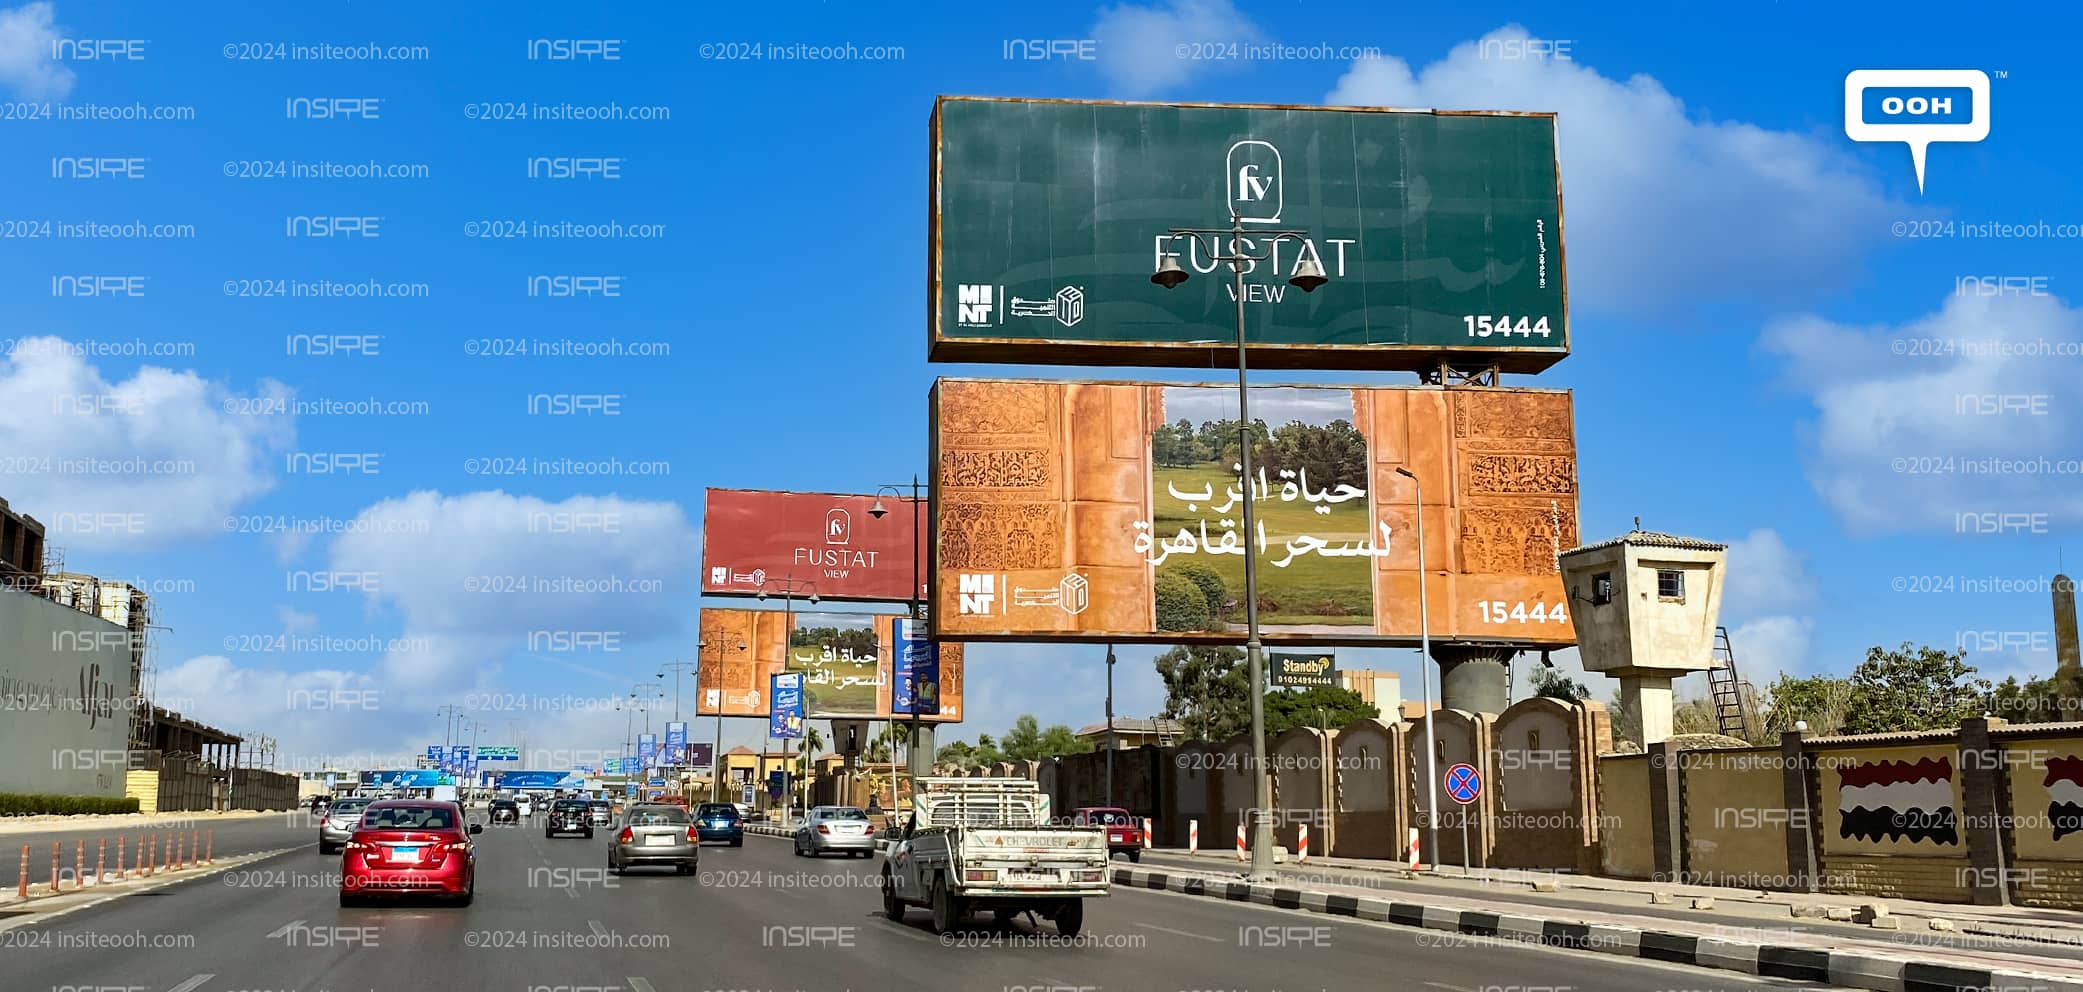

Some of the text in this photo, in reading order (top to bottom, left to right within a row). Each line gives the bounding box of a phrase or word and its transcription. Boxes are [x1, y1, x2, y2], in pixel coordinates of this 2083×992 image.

[1155, 235, 1356, 278] FUSTAT
[1463, 315, 1552, 338] 15444
[1279, 466, 1368, 515] حياة
[1270, 520, 1393, 568] لسحر
[793, 548, 879, 568] FUSTAT
[823, 569, 849, 579] VIEW
[1478, 600, 1568, 624] 15444
[794, 644, 837, 667] اقرب
[840, 647, 877, 668] حياة
[1283, 658, 1324, 676] Standby
